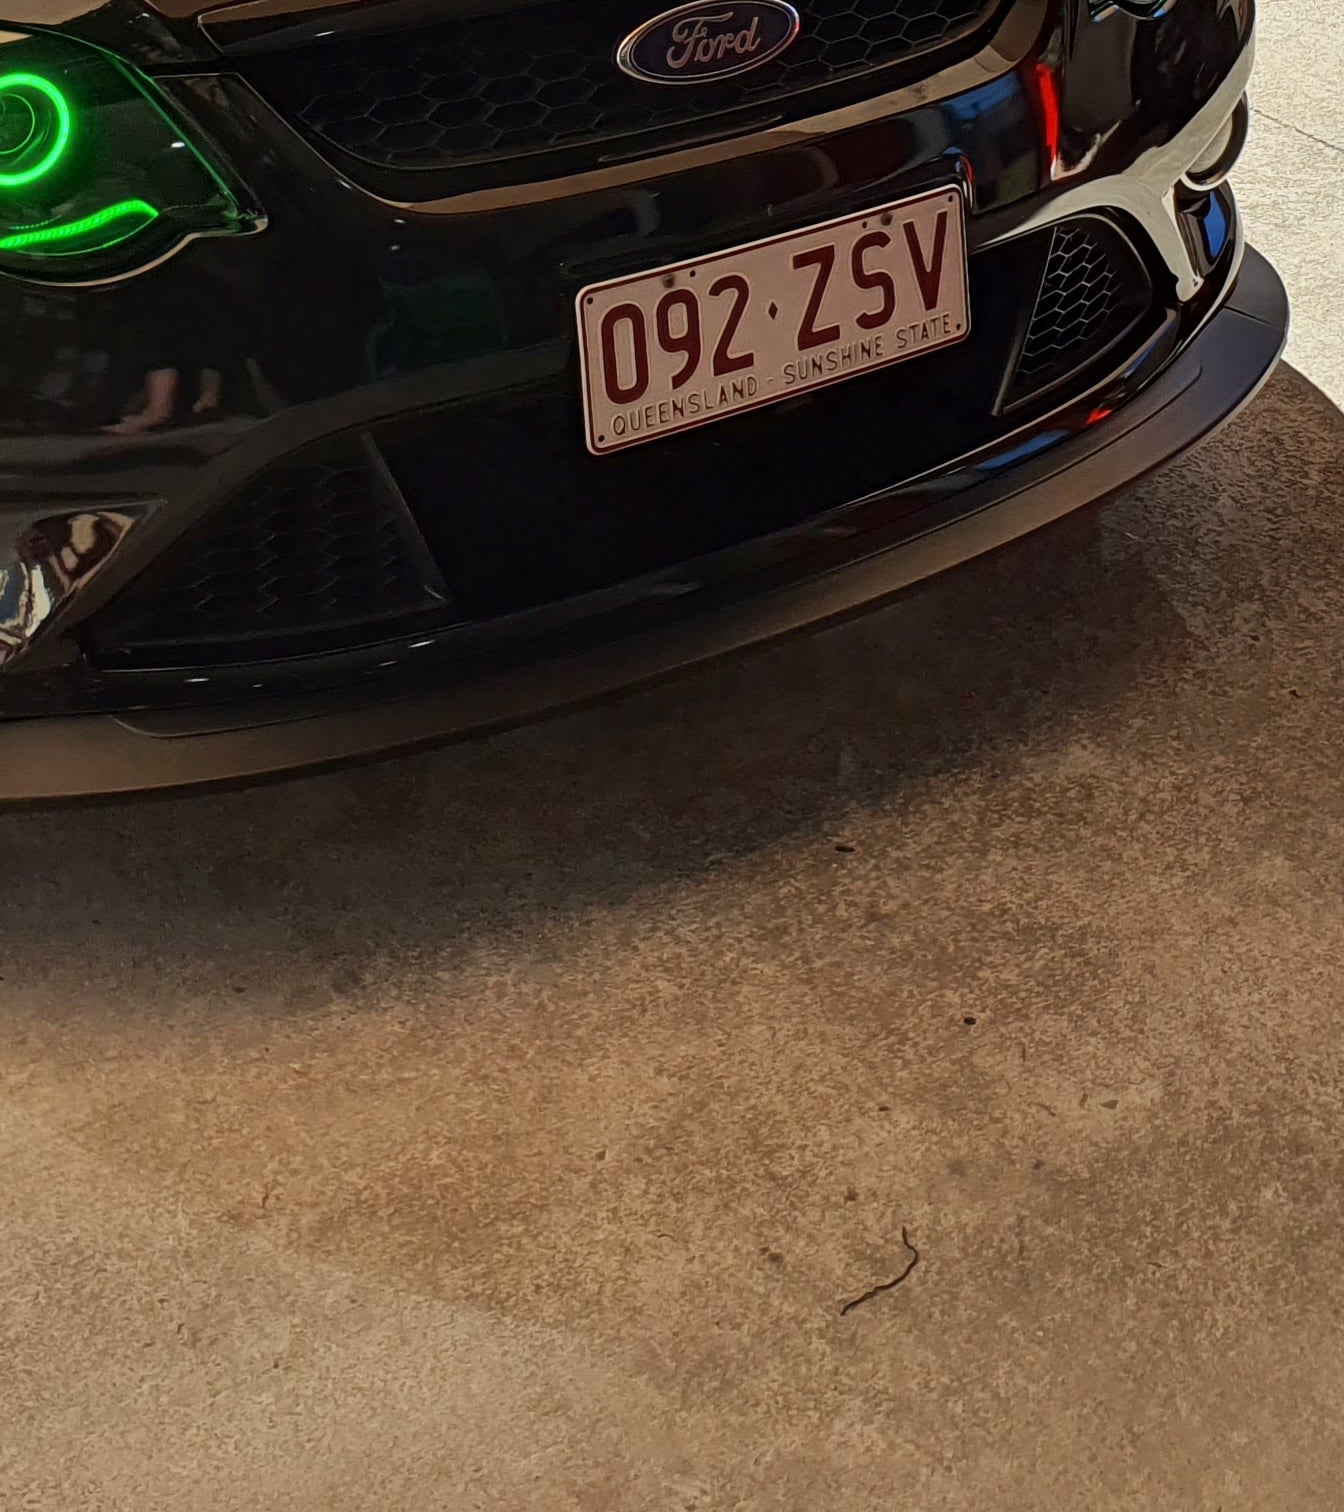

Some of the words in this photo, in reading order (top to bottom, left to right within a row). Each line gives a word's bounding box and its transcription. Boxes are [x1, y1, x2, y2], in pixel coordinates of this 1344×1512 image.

[665, 10, 761, 69] Ford
[612, 375, 758, 436] QUEENSLAND
[782, 335, 885, 386] SUNSHINE
[895, 313, 953, 347] STATE
